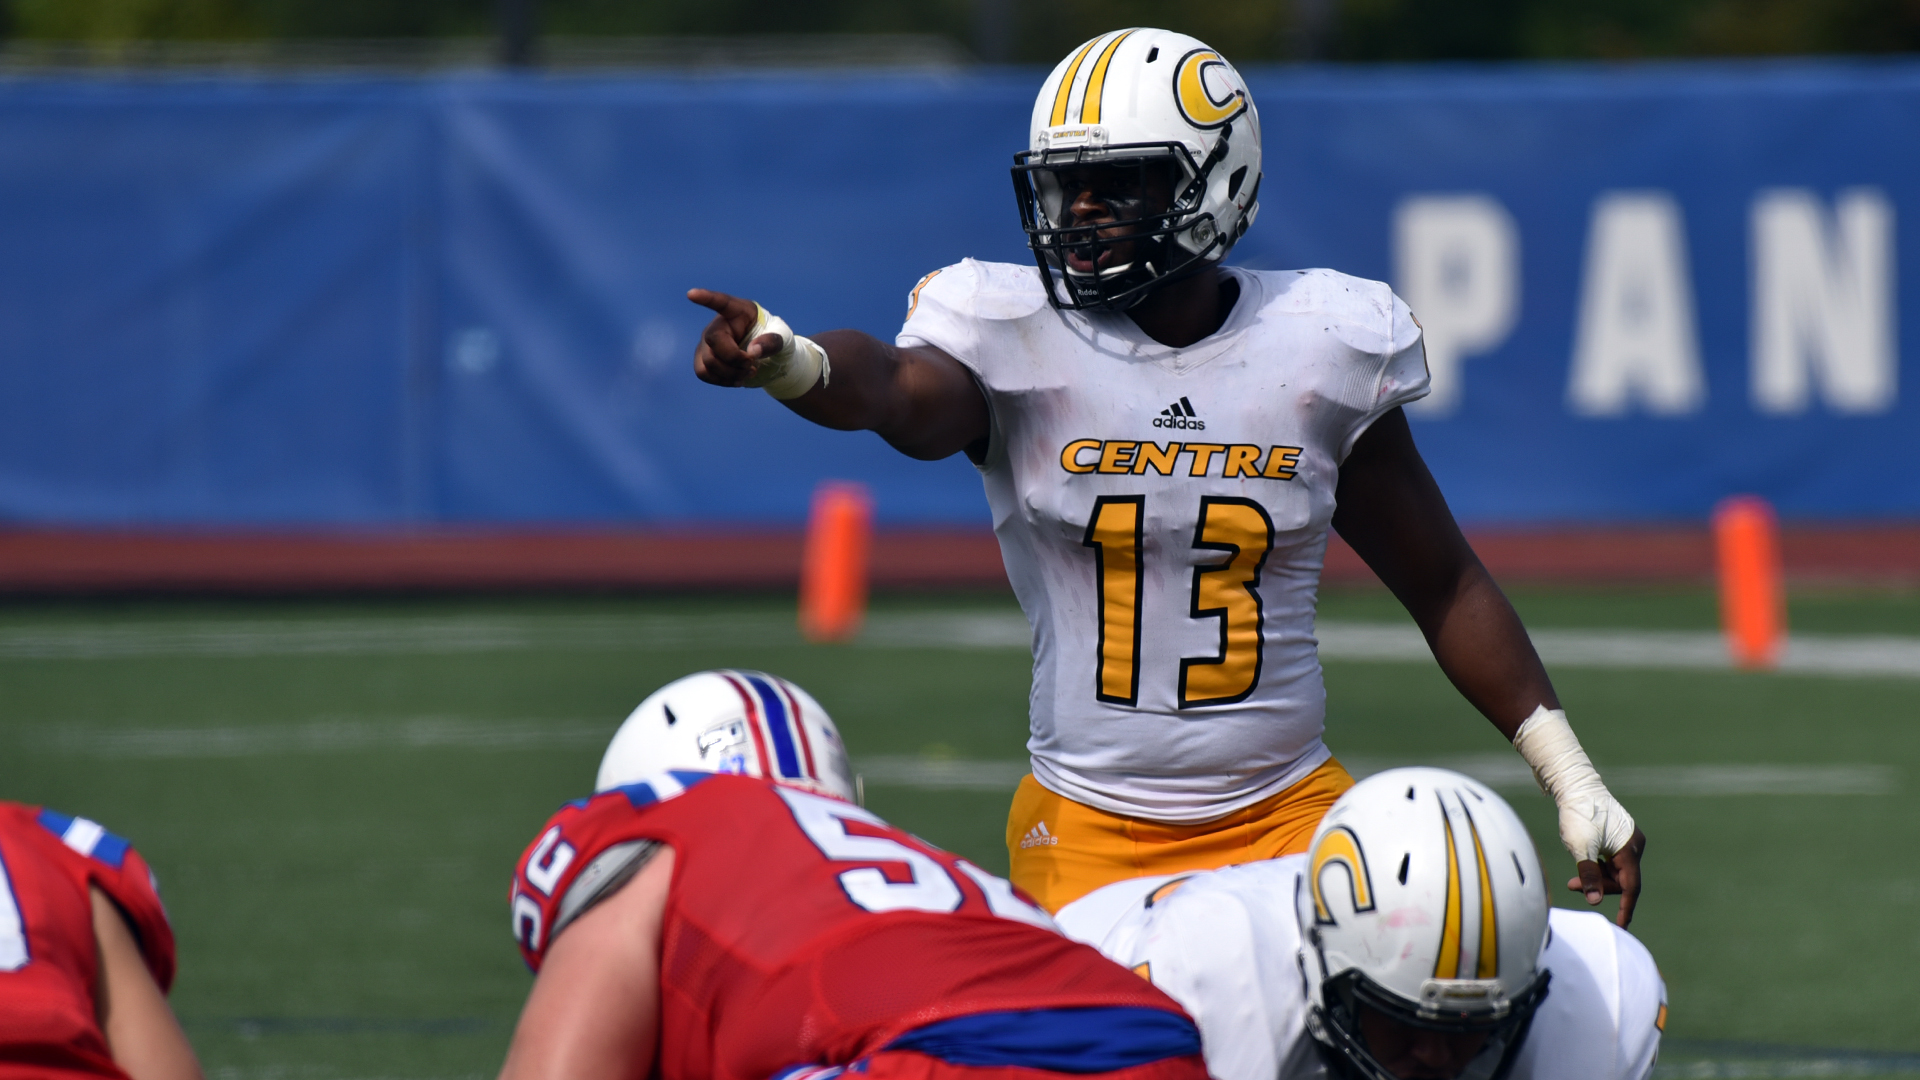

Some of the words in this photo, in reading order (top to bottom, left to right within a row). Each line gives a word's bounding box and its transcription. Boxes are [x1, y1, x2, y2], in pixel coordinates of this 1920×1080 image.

[1052, 130, 1087, 138] CENTRE
[1393, 191, 1897, 416] PAN
[1152, 415, 1206, 431] adidas
[1060, 438, 1304, 481] CENTRE
[1082, 494, 1275, 710] 13
[1020, 835, 1059, 849] adidas
